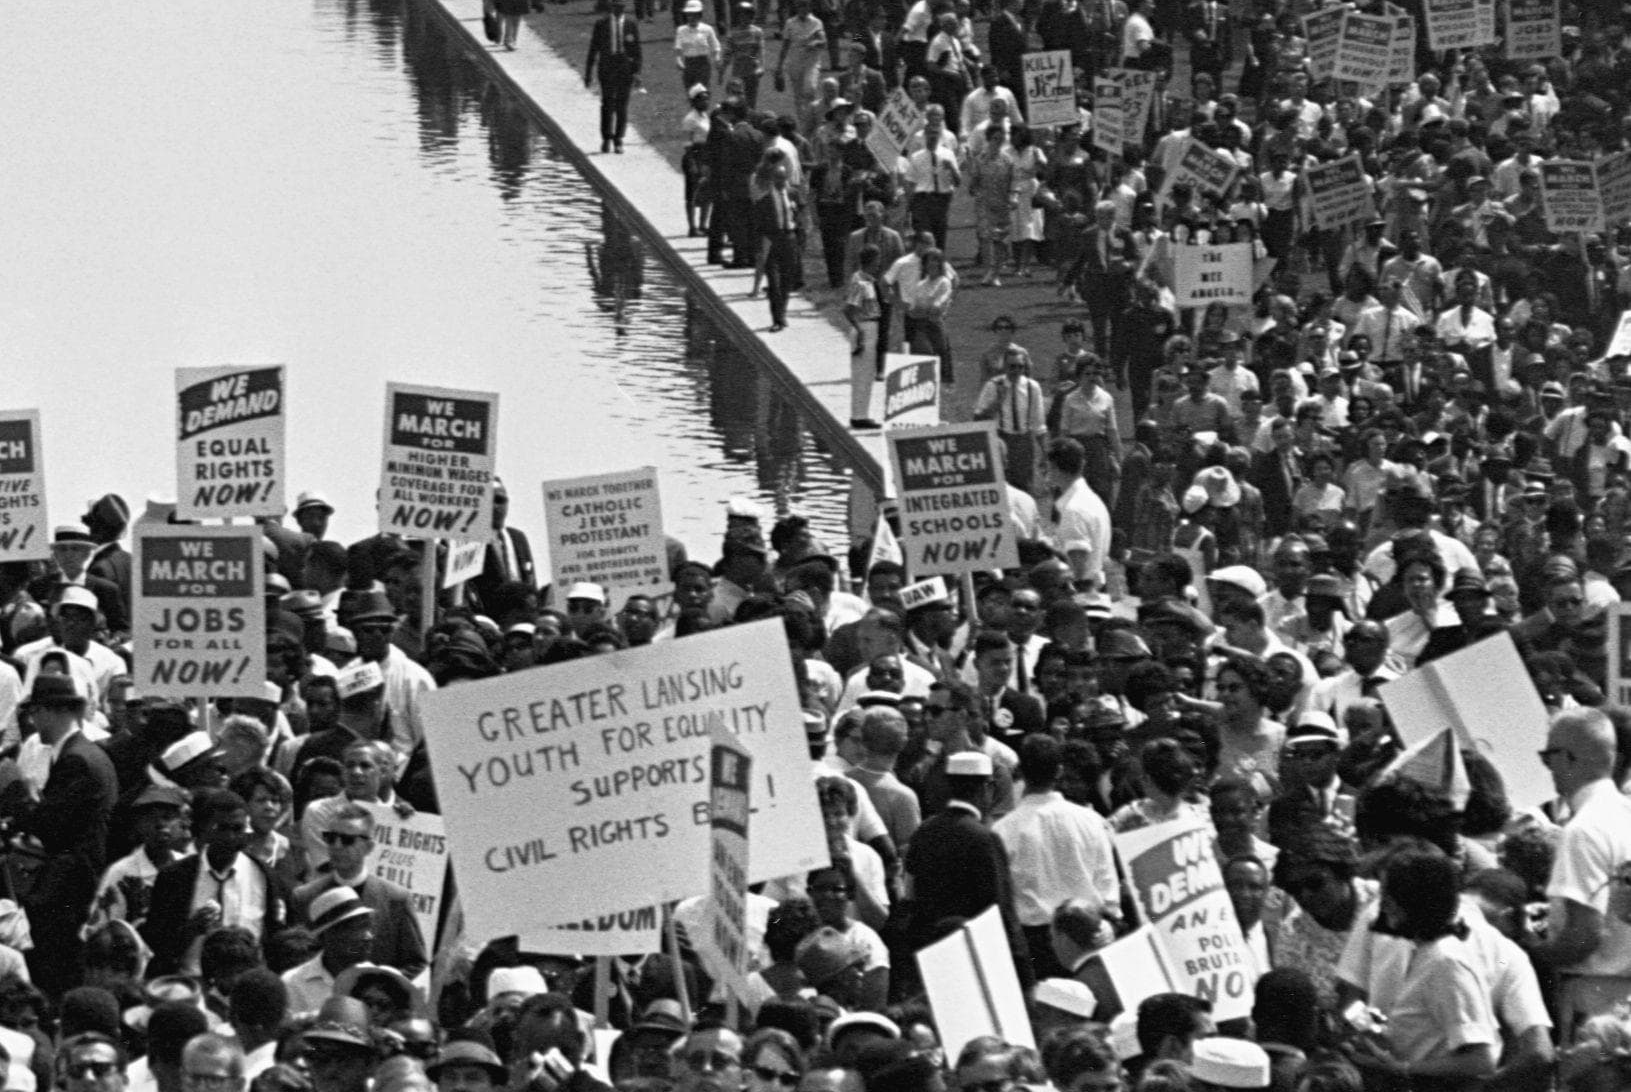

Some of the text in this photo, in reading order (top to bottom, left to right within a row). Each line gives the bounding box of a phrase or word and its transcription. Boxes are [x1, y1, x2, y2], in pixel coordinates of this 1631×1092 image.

[210, 374, 250, 402] WE
[900, 364, 919, 388] WE
[185, 389, 279, 432] DEMAND
[426, 400, 456, 416] WE
[397, 413, 482, 440] MARCH
[196, 437, 272, 457] EQUAL
[422, 438, 456, 449] FOR
[926, 438, 958, 454] WE
[195, 460, 274, 481] RIGHTS
[408, 451, 470, 468] HIGHER
[906, 452, 987, 476] MARCH
[387, 460, 491, 484] MINIMUM WAGES
[932, 473, 965, 486] FOR
[193, 479, 275, 507] NOW!
[390, 475, 485, 497] COVERAGE FOR
[393, 489, 481, 509] ALL WORKERS
[561, 496, 643, 517] CATHOLIC
[904, 489, 1000, 514] INTEGRATED
[391, 504, 479, 533] NOW!
[579, 512, 628, 529] JEWS
[909, 512, 1003, 536] SCHOOLS
[559, 523, 650, 546] PROTESTANT
[178, 540, 214, 557] WE
[921, 533, 1002, 564] NOW!
[149, 560, 246, 581] MARCH
[179, 583, 217, 595] FOR
[149, 608, 246, 633] JOBS
[153, 639, 243, 650] FOR ALL
[150, 655, 251, 685] NOW!
[476, 661, 745, 743] GREATER LANSING
[456, 723, 654, 795] YOUTH FOR
[570, 754, 706, 807] SUPPORTS
[398, 827, 447, 855] RIGHTS
[483, 838, 558, 874] CIVIL
[568, 812, 671, 854] RIGHTS
[1170, 909, 1208, 934] AN
